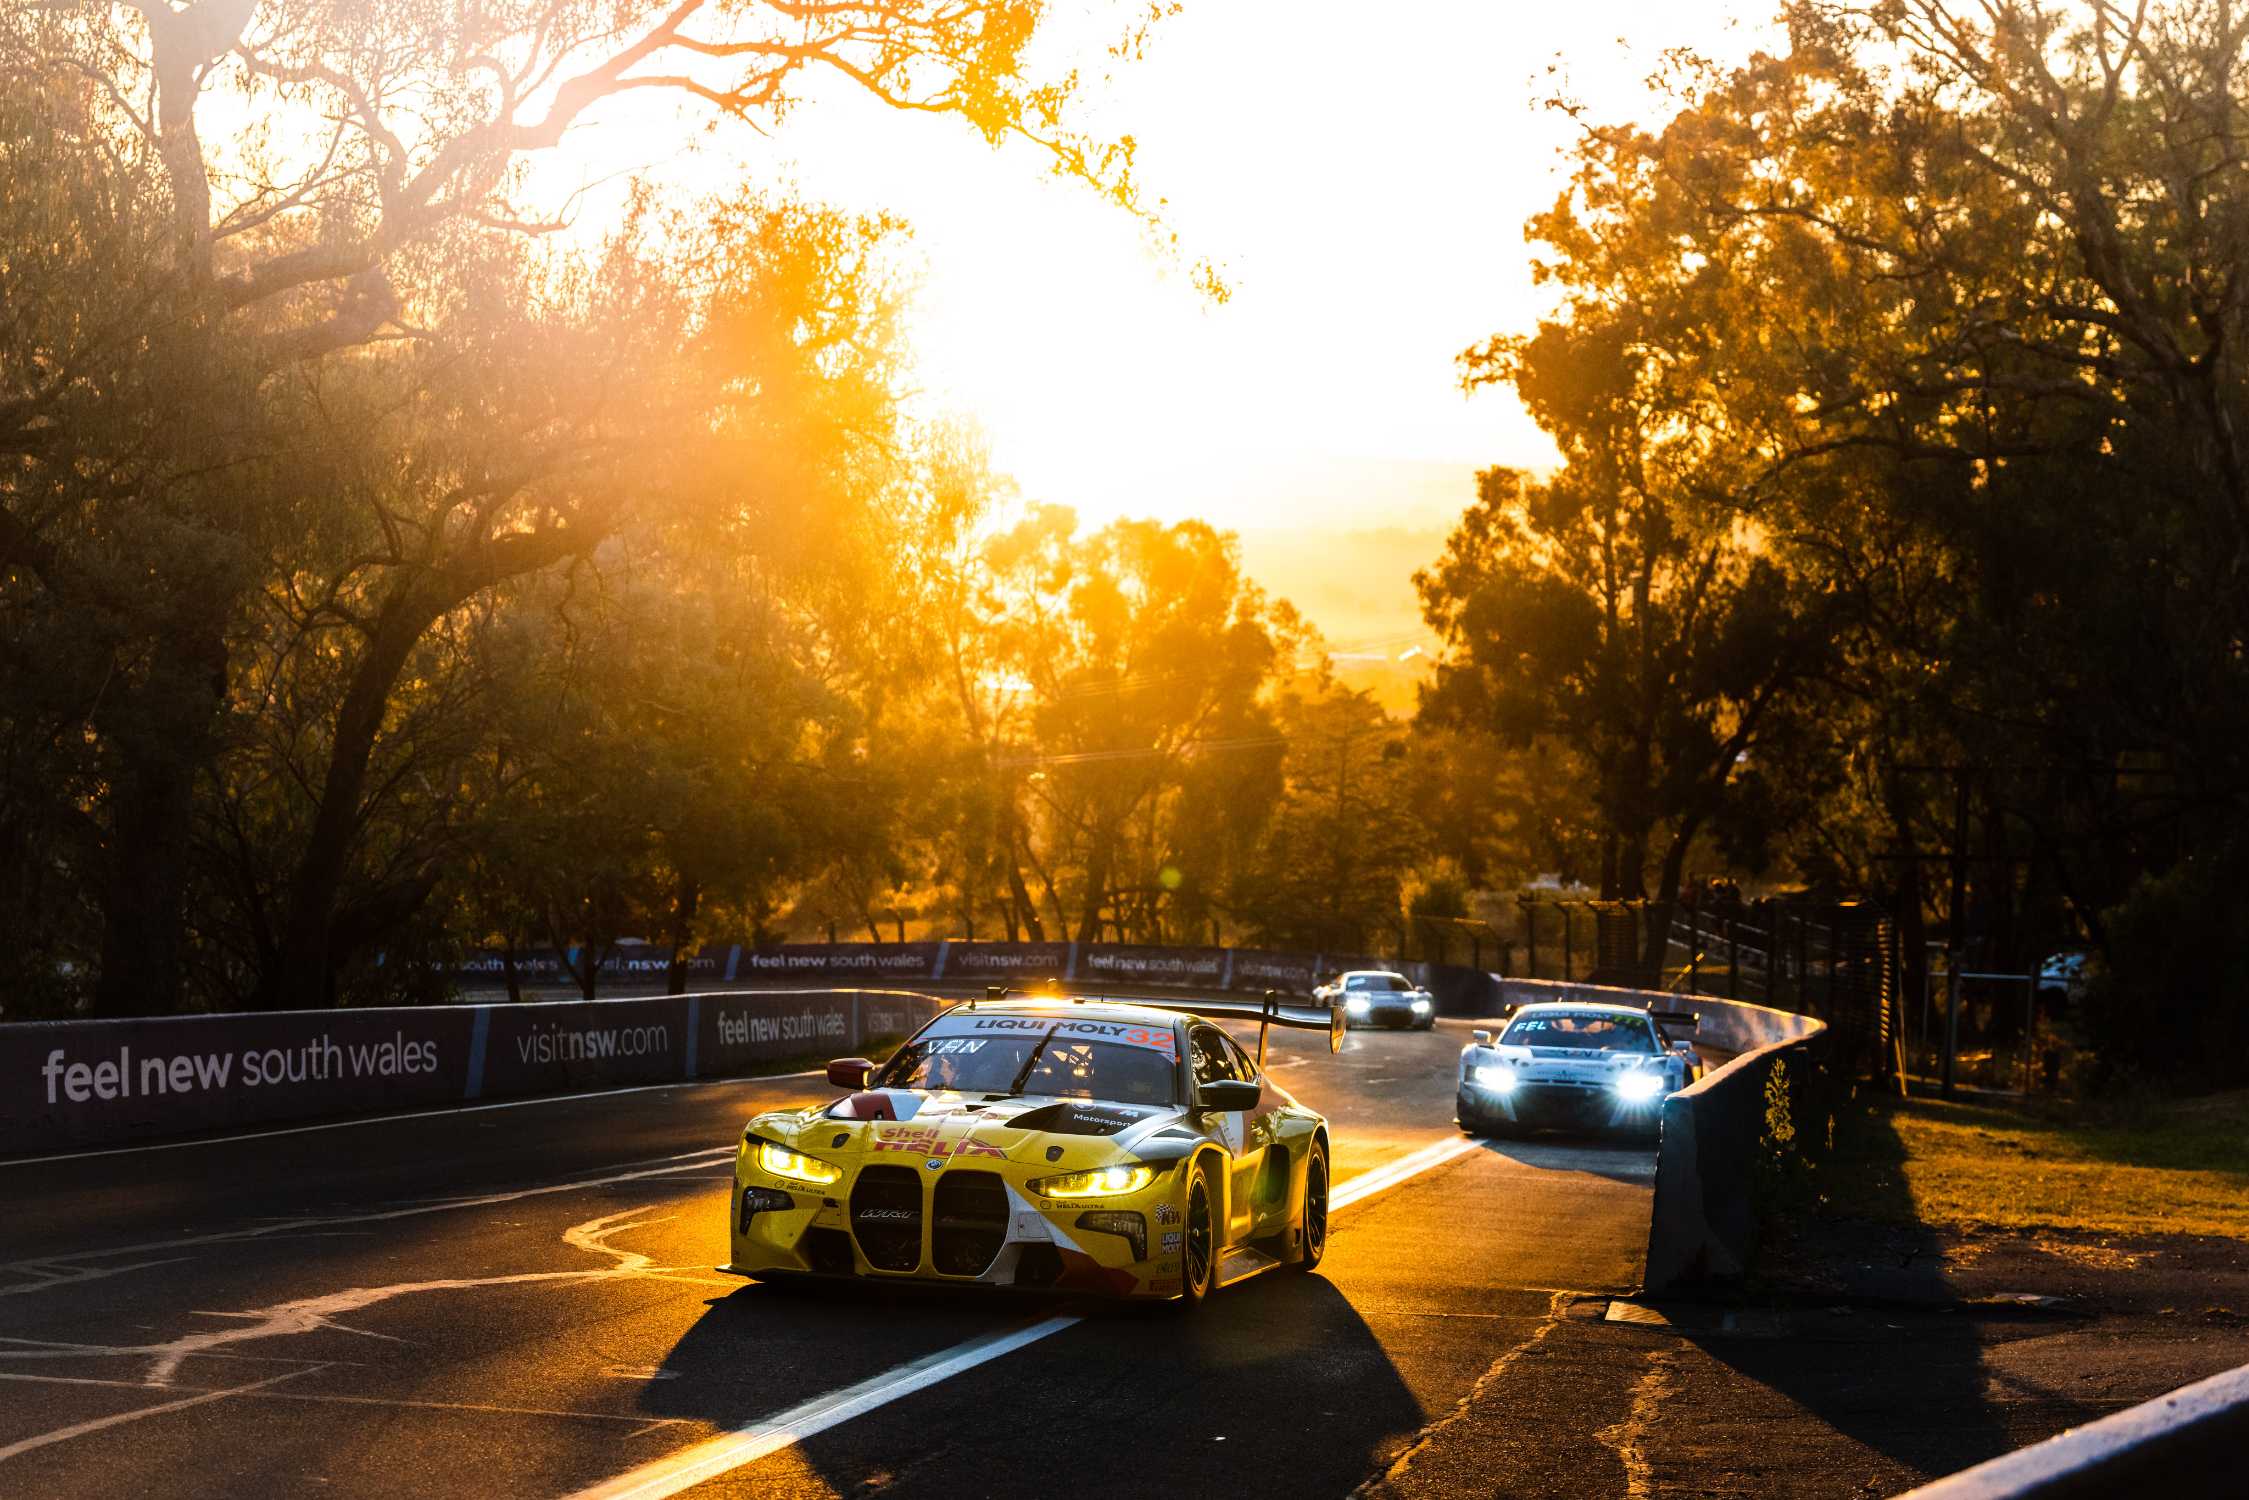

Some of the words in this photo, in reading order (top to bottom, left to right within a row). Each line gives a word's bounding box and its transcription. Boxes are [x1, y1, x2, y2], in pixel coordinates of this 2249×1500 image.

[751, 953, 785, 968] feel
[788, 955, 826, 968] new
[829, 953, 877, 968] south
[879, 953, 925, 968] wales
[958, 952, 1058, 968] visitnsw.com
[1115, 955, 1146, 971] new
[1149, 956, 1183, 973] south
[717, 1009, 749, 1045] feel
[750, 1016, 781, 1042] new
[782, 1007, 817, 1039] south
[817, 1006, 846, 1038] wales
[975, 1019, 1047, 1030] LIQUI
[1053, 1020, 1129, 1038] MOLY
[1126, 1028, 1174, 1049] 32
[1514, 1020, 1546, 1032] FEL
[517, 1023, 668, 1065] visitnsw.com
[927, 1039, 988, 1055] VAN
[41, 1045, 129, 1104] feel
[140, 1052, 233, 1097] new
[241, 1032, 343, 1087] south
[348, 1030, 438, 1079] wales
[882, 1126, 940, 1139] Shell
